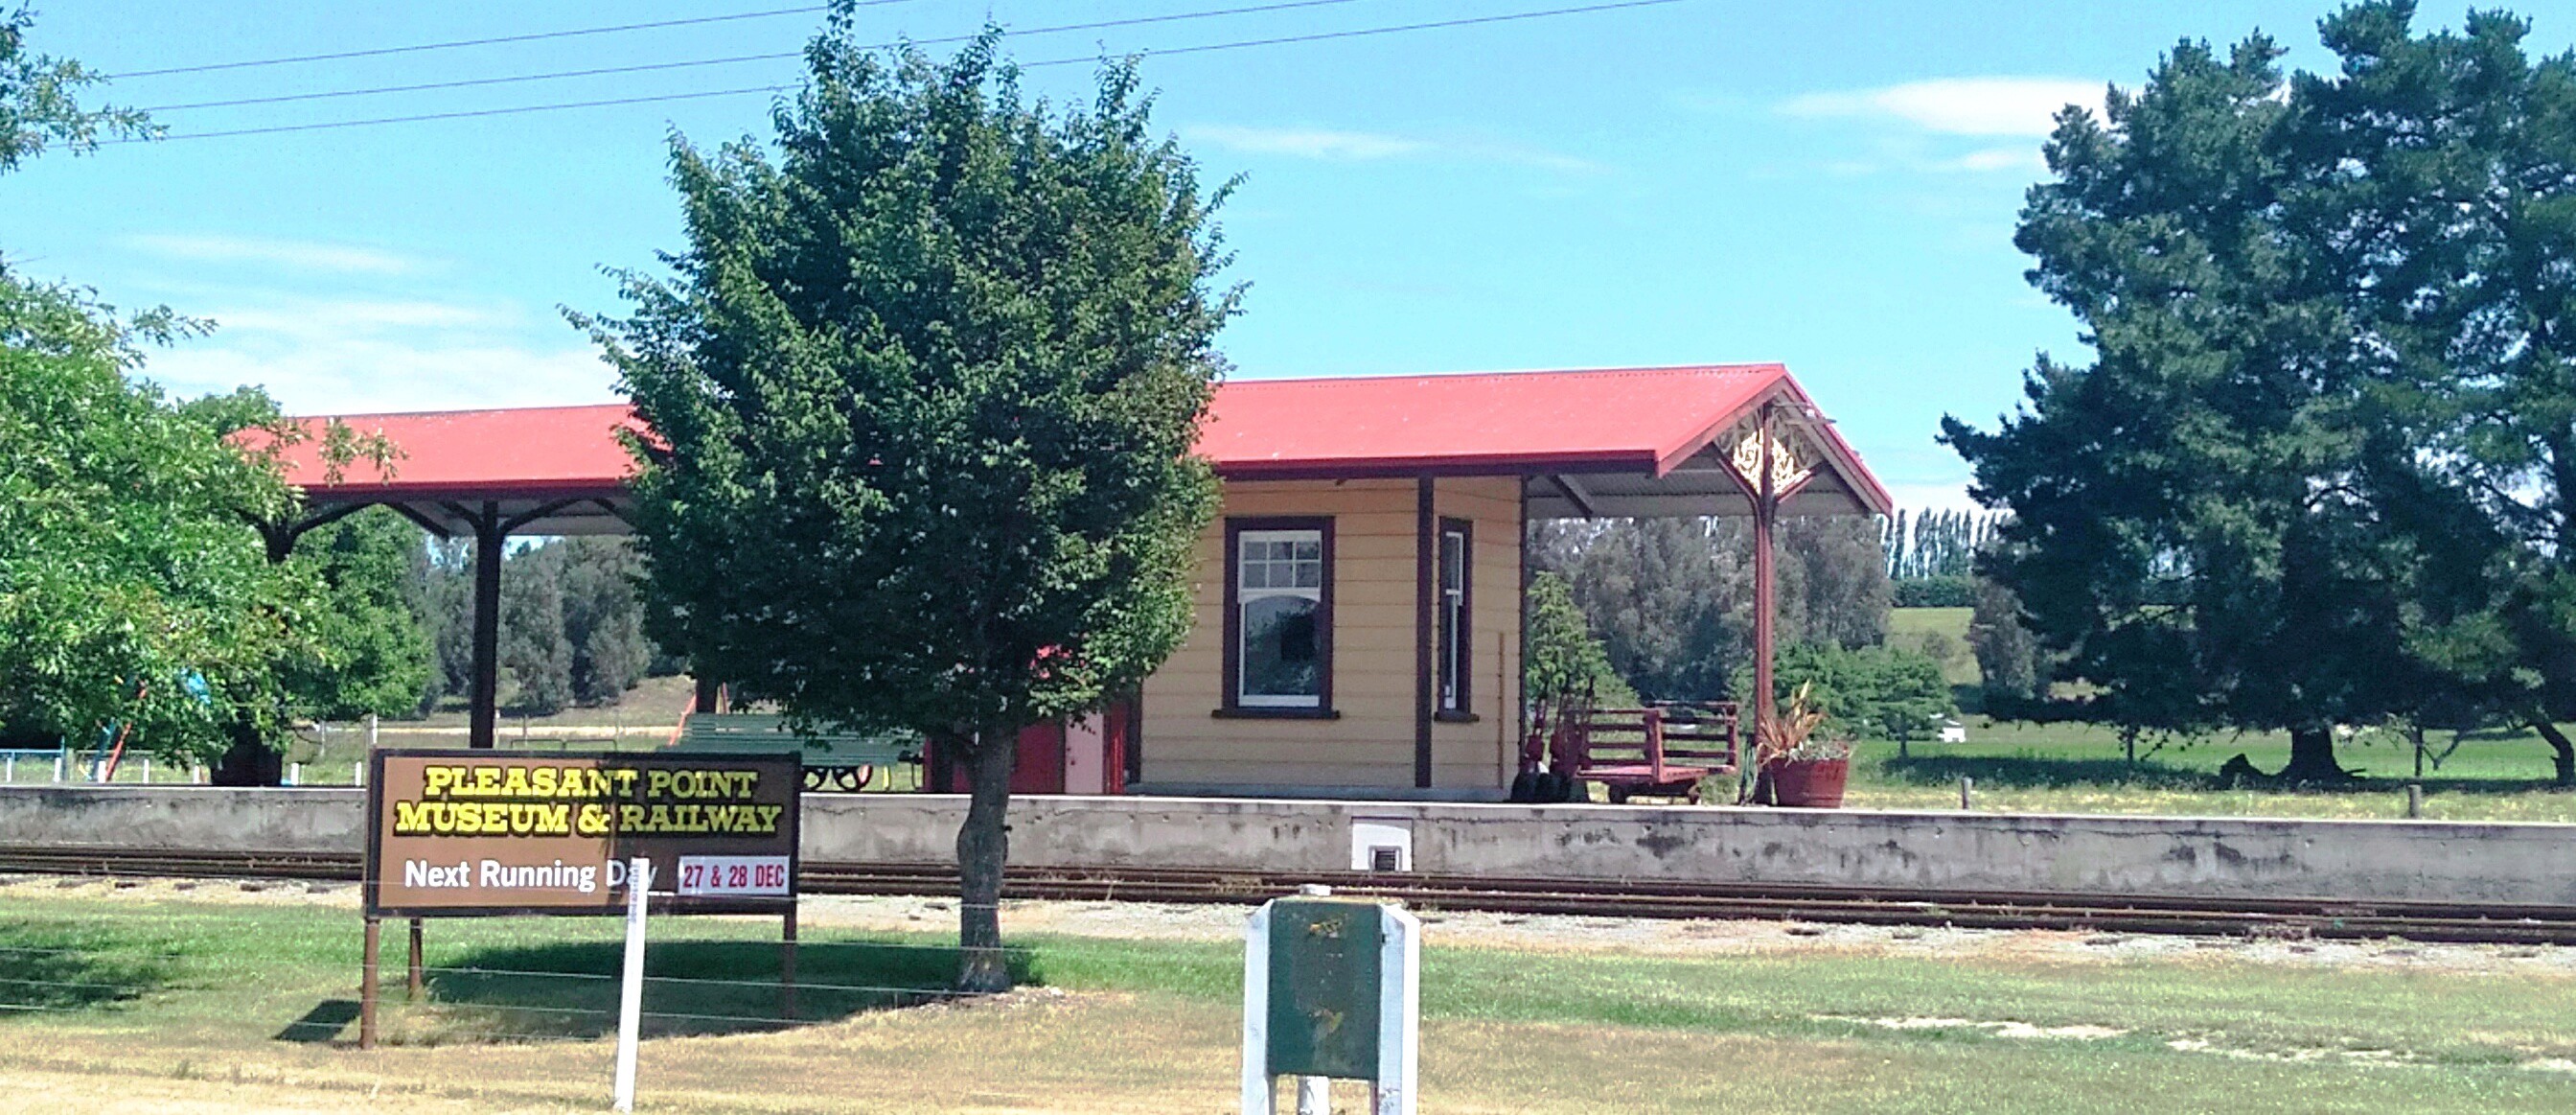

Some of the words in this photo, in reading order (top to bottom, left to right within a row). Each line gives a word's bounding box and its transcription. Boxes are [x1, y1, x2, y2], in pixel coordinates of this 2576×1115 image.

[424, 767, 638, 798] PLEASANT
[647, 770, 759, 799] POINT
[396, 801, 570, 833] MUSEUM
[578, 803, 611, 833] &
[619, 803, 783, 833] RAILWAY
[404, 859, 471, 888] Next
[479, 859, 597, 894] Running
[606, 858, 658, 891] Dy
[683, 865, 704, 888] 27
[710, 865, 723, 888] &
[728, 865, 748, 888] 28
[755, 865, 785, 888] DEC
